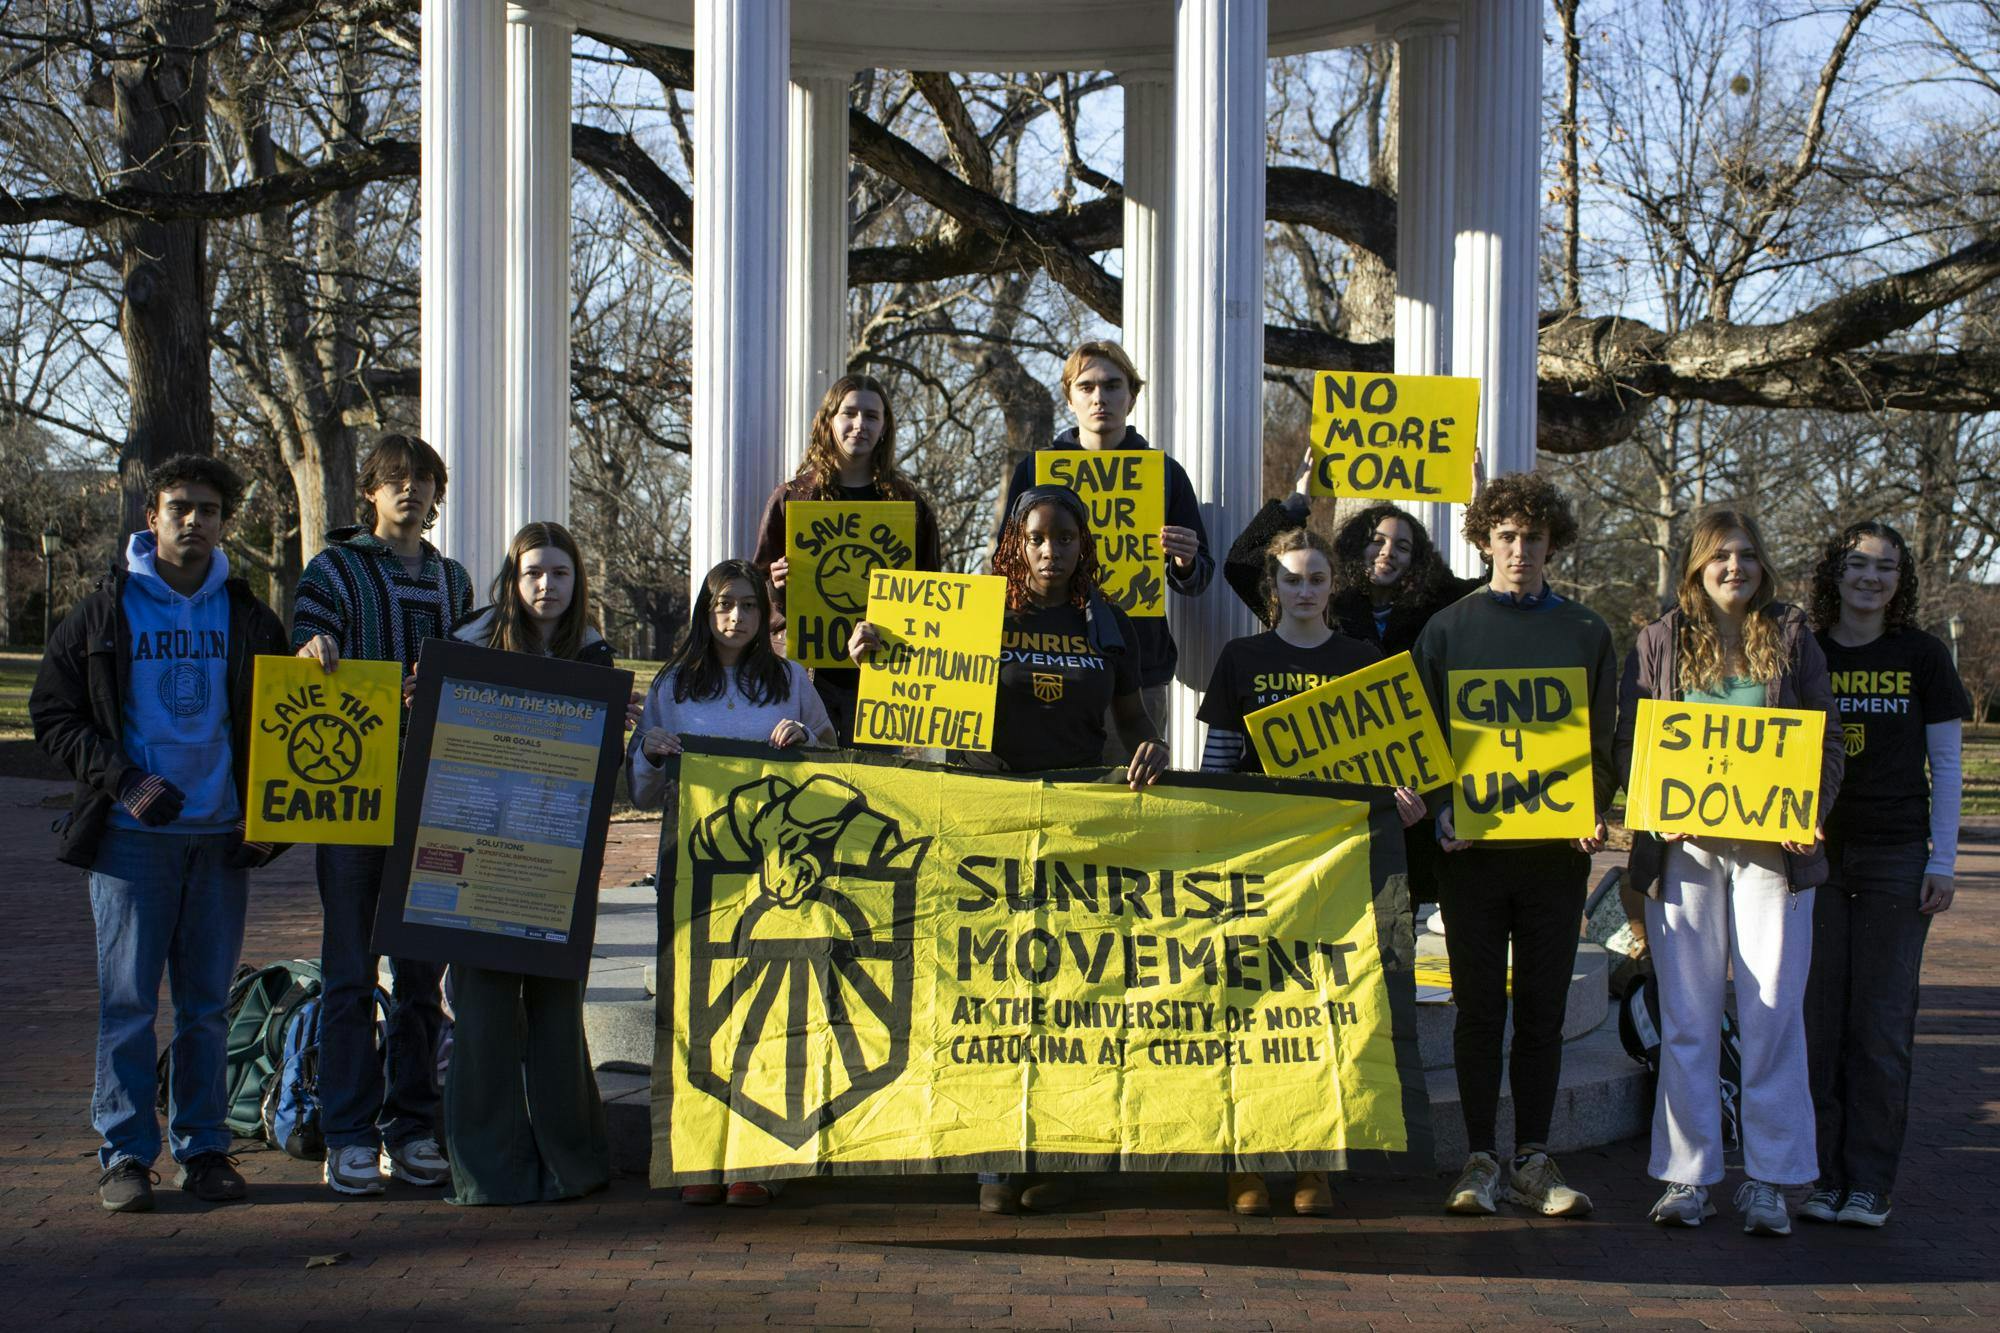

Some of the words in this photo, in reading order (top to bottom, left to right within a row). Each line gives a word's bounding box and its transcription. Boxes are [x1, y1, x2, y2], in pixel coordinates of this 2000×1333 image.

[1324, 375, 1397, 414] NO
[1324, 417, 1455, 453] MORE
[1050, 457, 1143, 492] SAVE
[1318, 453, 1442, 494] COAL
[1084, 497, 1135, 530] UR
[795, 513, 861, 557] SAVE
[870, 523, 912, 569] OUR
[1091, 533, 1159, 562] TURE
[871, 574, 971, 611] INVEST
[134, 630, 225, 660] AROLIN
[798, 615, 864, 662] HO
[904, 618, 940, 638] IN
[1002, 631, 1097, 655] UNRIS
[869, 640, 1000, 685] COMMUNITY
[1000, 651, 1104, 670] OVEMENT
[892, 681, 936, 701] NOT
[1254, 672, 1342, 692] SUNRI
[1830, 671, 1911, 694] NRISE
[261, 684, 326, 741] SAVE
[340, 692, 383, 737] THE
[454, 688, 496, 704] STUCK
[500, 694, 514, 708] IN
[519, 697, 543, 712] THE
[547, 702, 594, 721] SMOKE
[1456, 677, 1573, 724] GND
[1835, 698, 1909, 713] EMENT
[1262, 672, 1422, 768] CLIMATE
[1659, 713, 1803, 758] SHUT
[493, 734, 512, 744] OUR
[513, 737, 543, 748] GOALS
[1500, 728, 1522, 762] 4
[1706, 754, 1733, 775] it
[262, 779, 381, 822] EARTH
[1462, 770, 1575, 815] UNC
[1660, 778, 1814, 830] DOWN
[476, 838, 525, 852] SOLUTIONS
[956, 855, 1267, 919] SUNRISE
[957, 926, 1358, 992] MOVEMENT
[952, 996, 981, 1025] AT
[995, 998, 1046, 1026] THE
[1055, 999, 1215, 1031] UNIVERSITY
[1225, 1005, 1257, 1033] OF
[1266, 1001, 1358, 1029] NORTH
[951, 1035, 1087, 1065] CAROLINA
[1098, 1037, 1127, 1066] AT
[1148, 1038, 1251, 1066] CHAPEL
[1262, 1036, 1320, 1063] HILL
